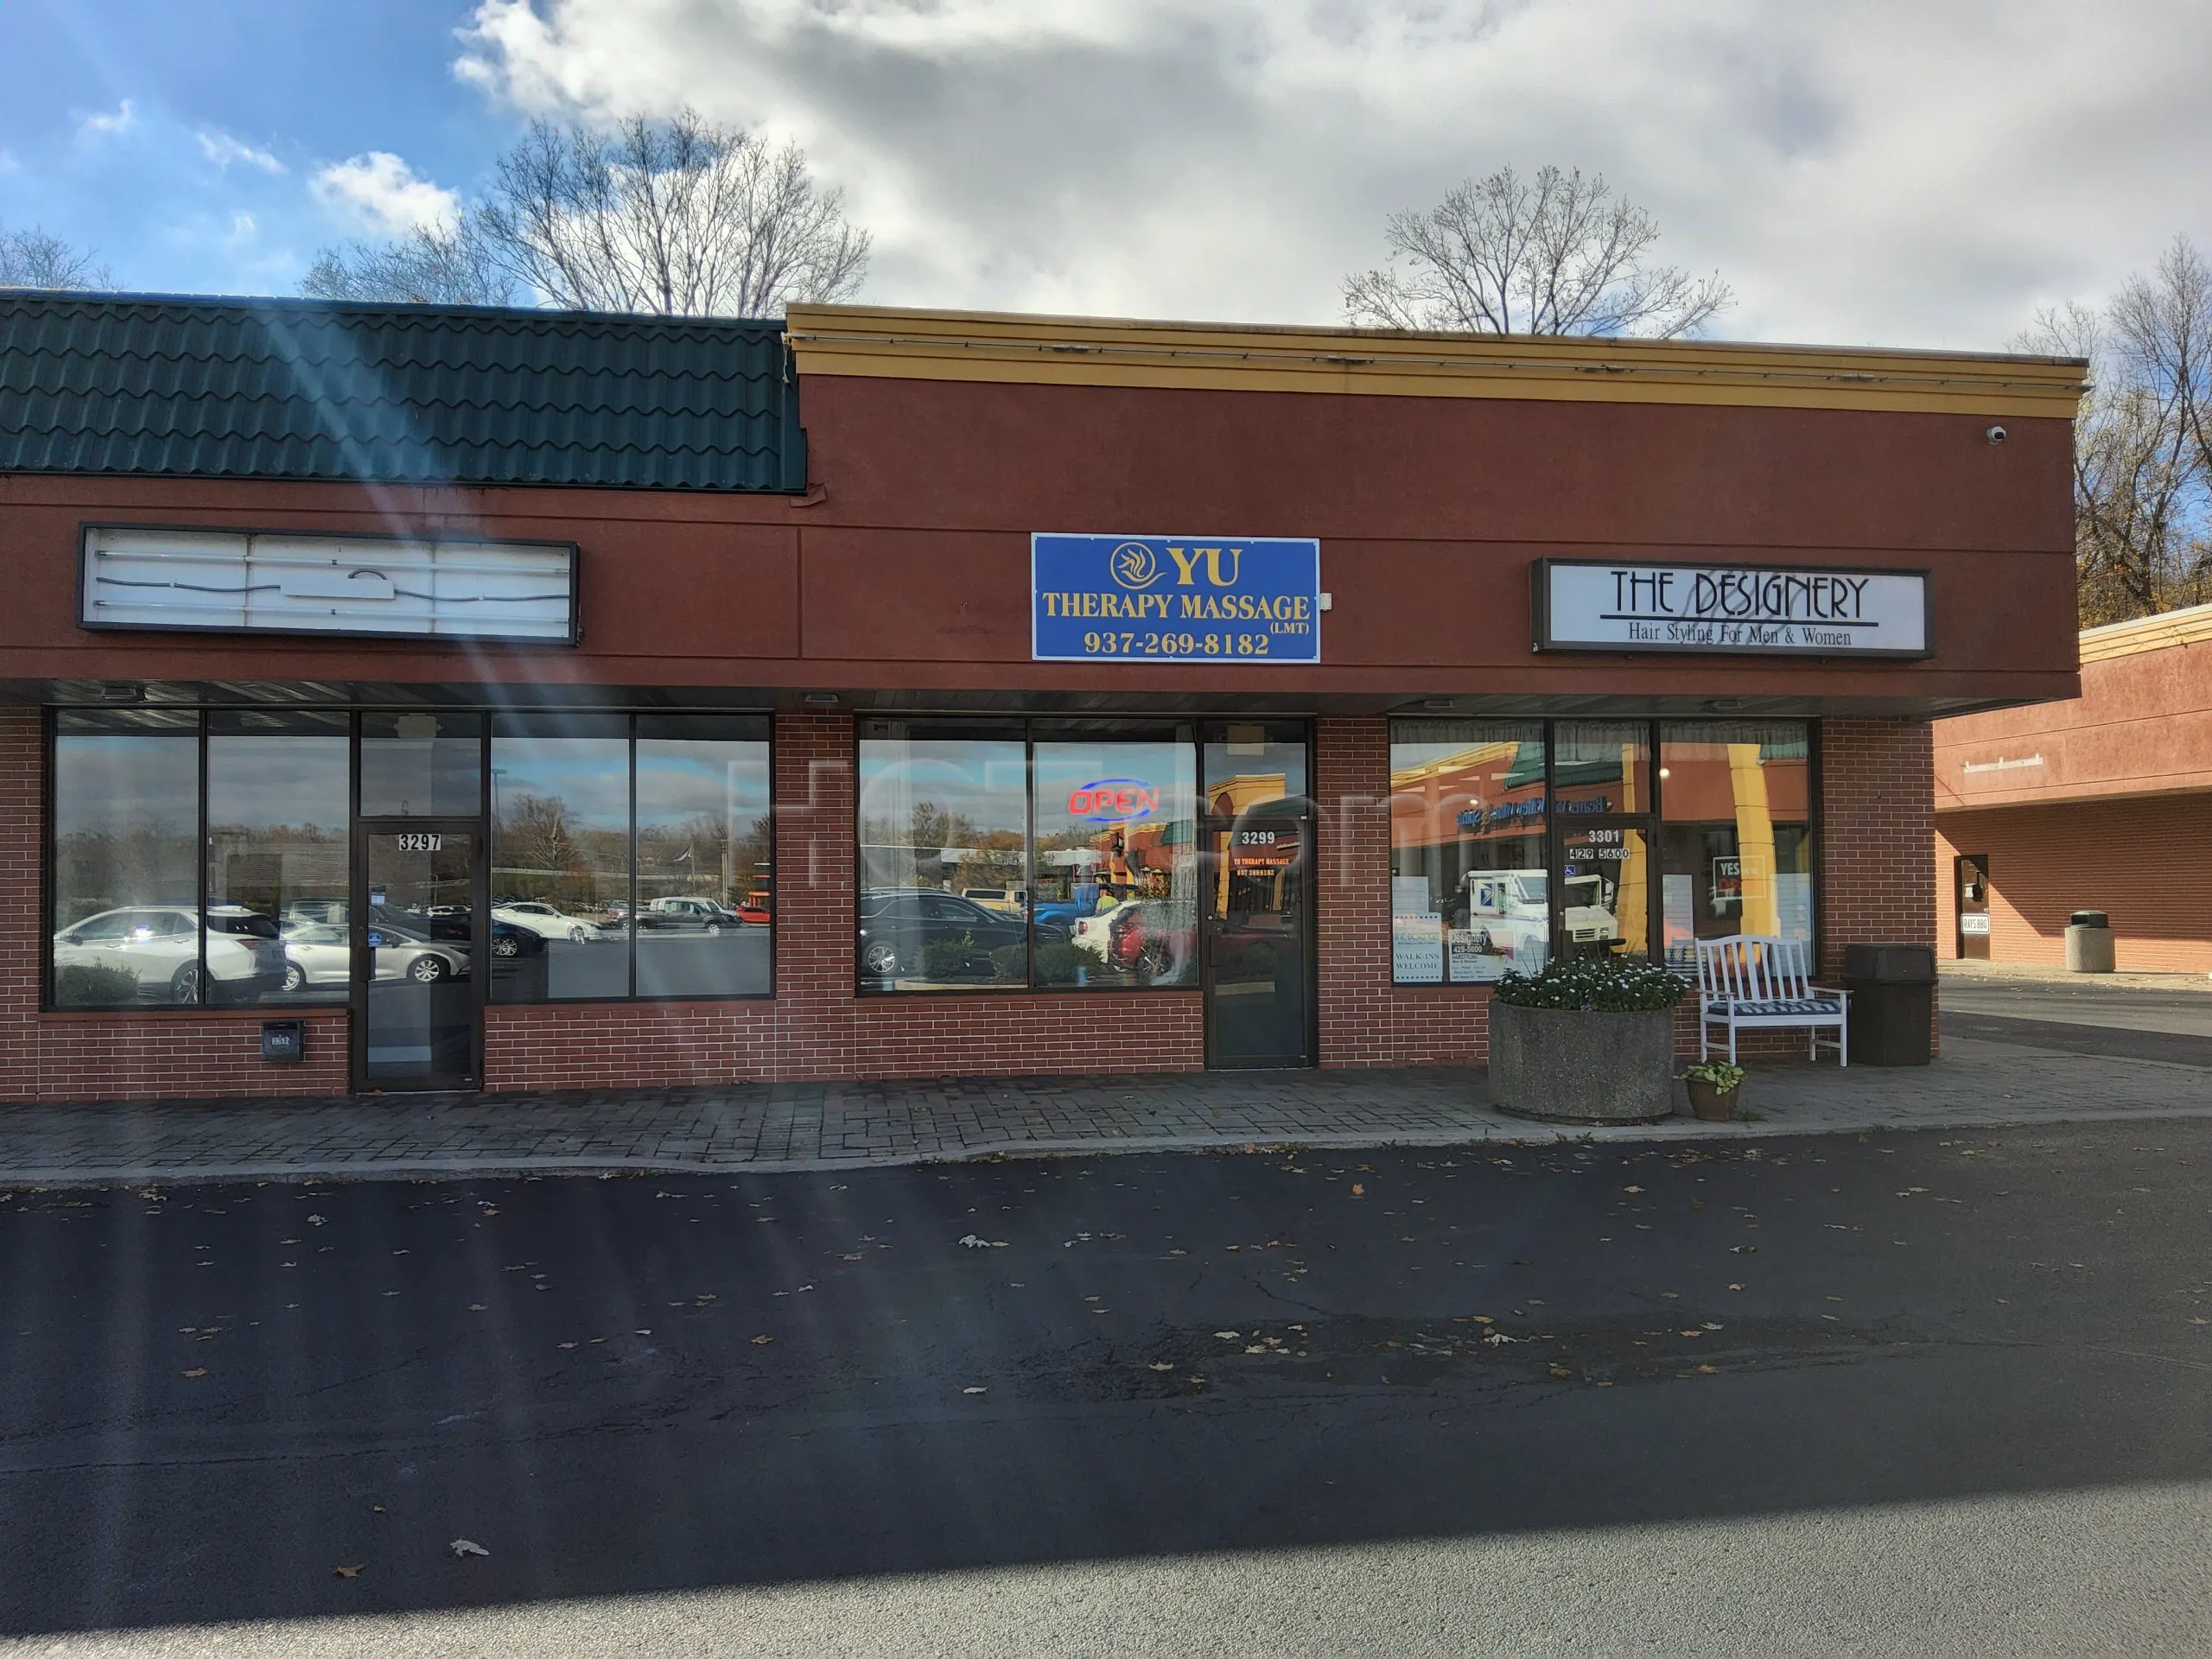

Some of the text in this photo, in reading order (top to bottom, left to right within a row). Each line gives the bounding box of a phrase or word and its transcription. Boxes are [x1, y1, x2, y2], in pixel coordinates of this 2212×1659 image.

[1166, 547, 1244, 587] YU
[1611, 571, 1870, 619] THE DESIGNERY
[1042, 592, 1310, 620] THERAPY MASSAGE
[1269, 621, 1310, 635] (LMT)
[1629, 622, 1852, 645] Hair Styling For Men & Women
[1084, 632, 1269, 656] 937-269-8182
[1068, 787, 1160, 815] OPEN
[400, 834, 440, 850] 3297
[1242, 831, 1275, 844] 3299
[1588, 830, 1619, 842] 3301
[1570, 849, 1630, 859] 429 5600
[1720, 862, 1740, 876] YES
[1452, 931, 1487, 946] Designery
